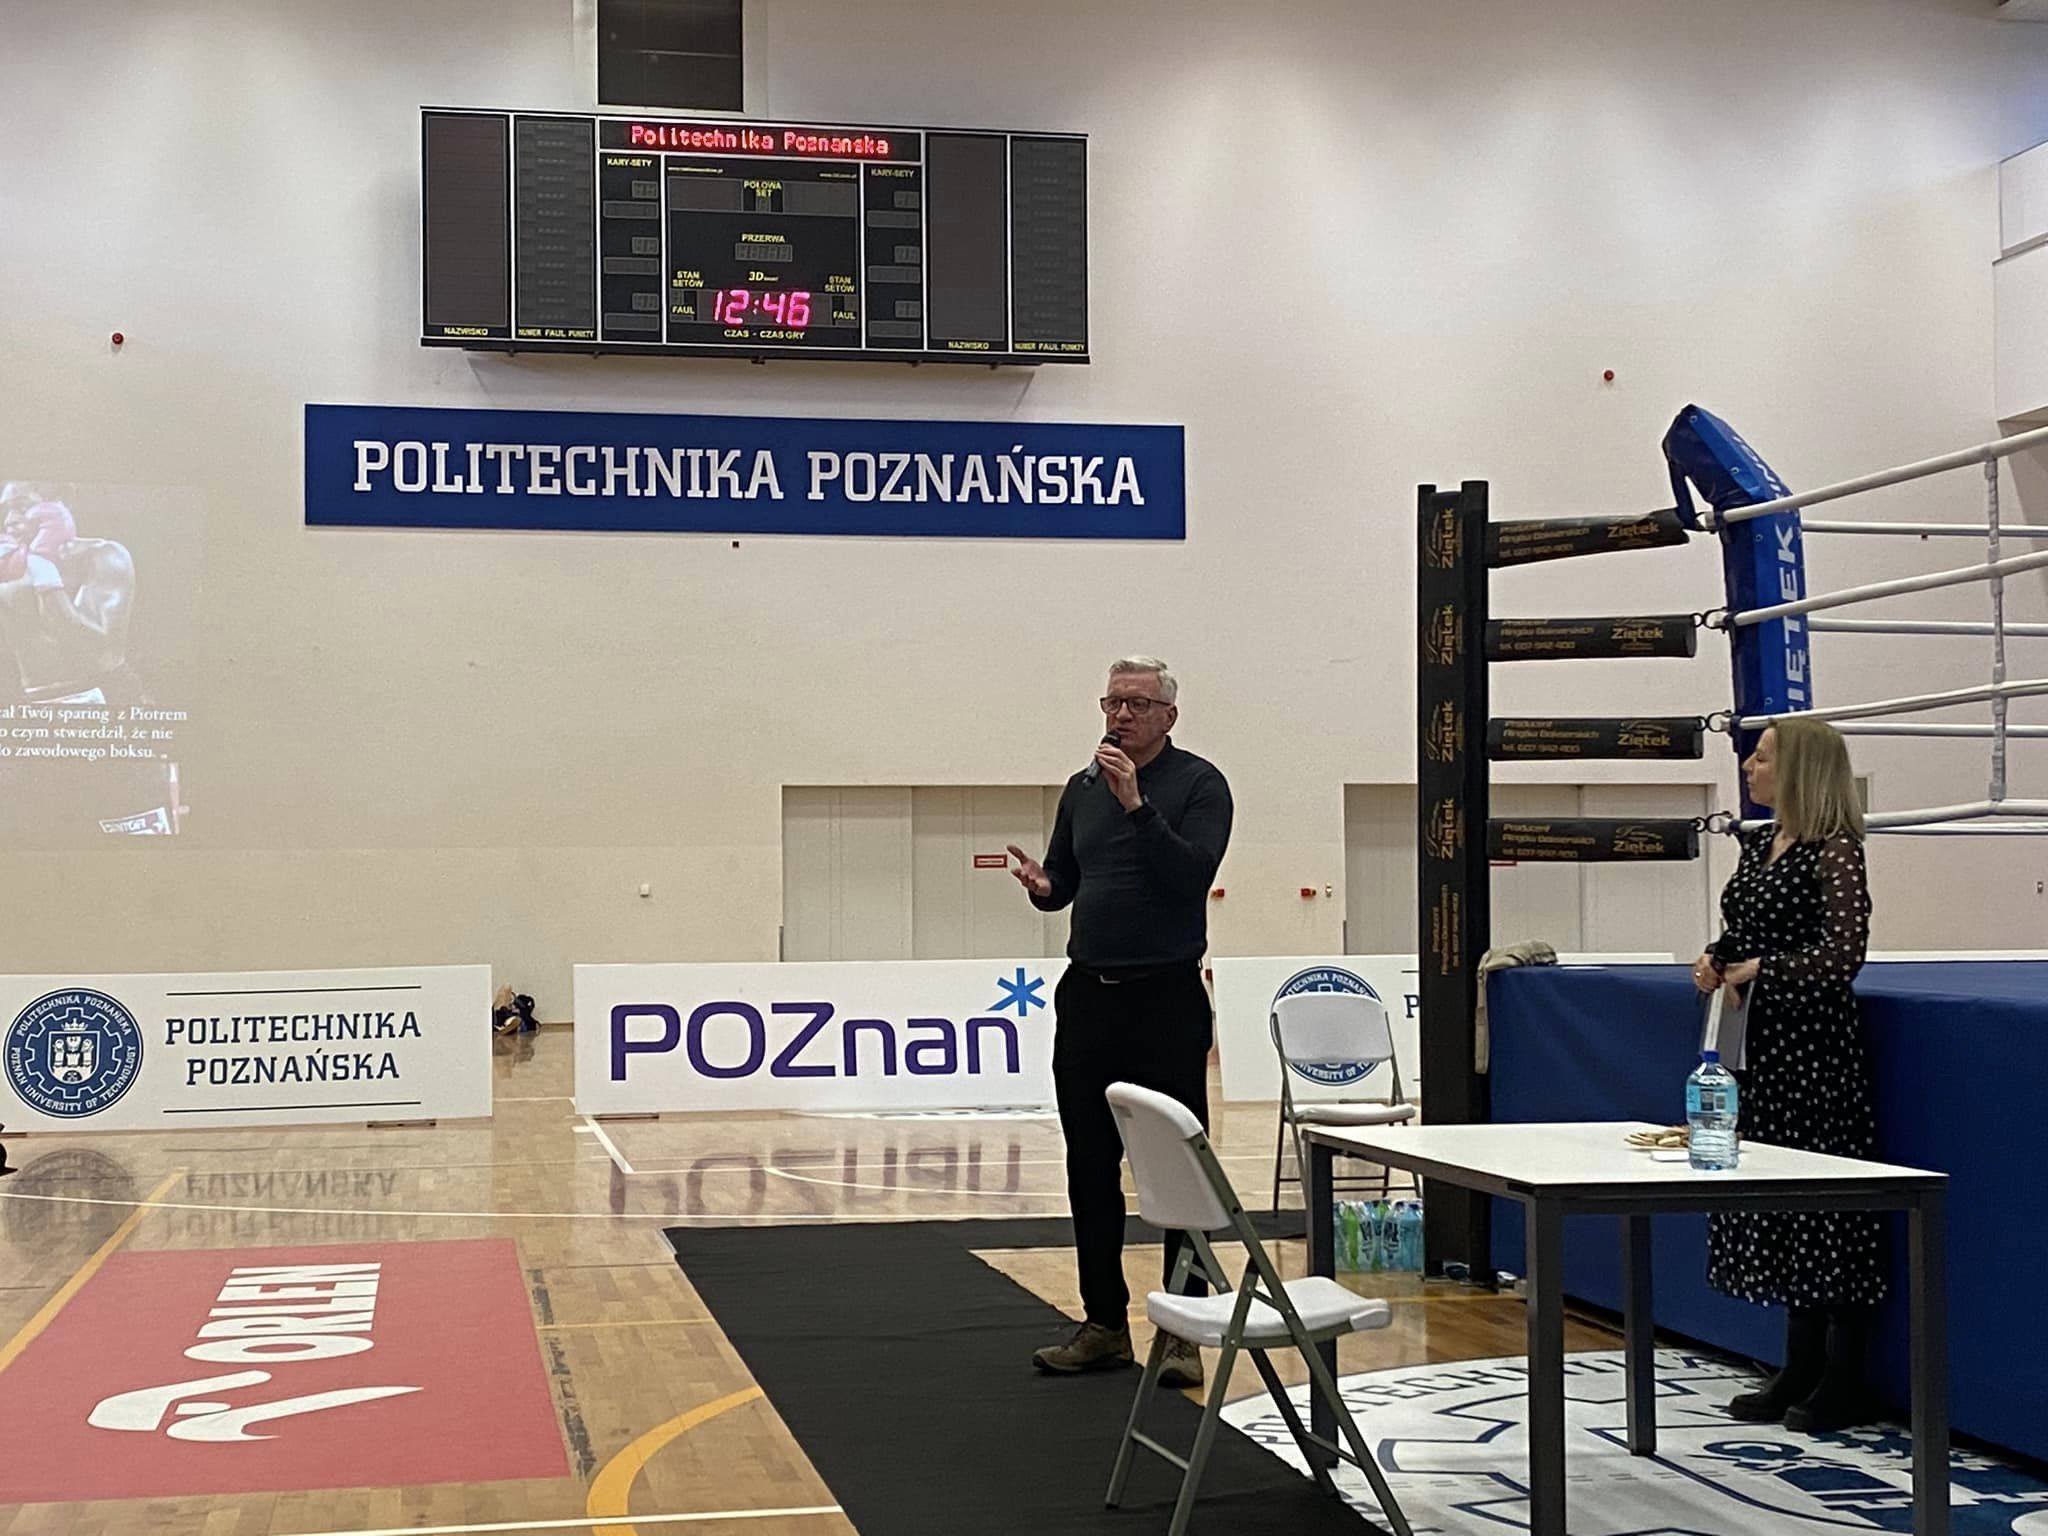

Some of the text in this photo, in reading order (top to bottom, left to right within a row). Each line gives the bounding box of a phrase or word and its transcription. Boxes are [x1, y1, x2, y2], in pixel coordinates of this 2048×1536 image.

[631, 125, 889, 154] Politechnika Poznanska
[742, 234, 785, 243] PRZERWA
[677, 271, 700, 279] STAN
[829, 276, 851, 284] STAN
[672, 306, 695, 314] FAUL
[714, 290, 811, 326] 12:46
[833, 311, 856, 320] FAUL
[724, 330, 749, 338] CZAS
[760, 331, 784, 339] CZAS
[786, 331, 805, 339] GRY
[353, 440, 1145, 506] POLITECHNIKA POZNAŃSKA
[1775, 521, 1806, 712] IĘTEK
[1611, 626, 1664, 642] Ziętek
[18, 705, 53, 723] Twój
[57, 706, 110, 723] sparing
[118, 711, 126, 720] z
[130, 706, 187, 720] Piotrem
[12, 728, 49, 741] czym
[131, 727, 147, 739] że
[152, 726, 174, 739] nie
[1617, 733, 1672, 749] Ziętek
[16, 743, 106, 761] zawodowego
[1613, 839, 1665, 856] Ziętek
[16, 995, 80, 1037] POLITECHNIKA
[165, 1010, 422, 1045] POLITECHNIKA
[186, 1047, 400, 1086] POZNAŃSKA
[24, 1084, 83, 1112] UNIVERSITY
[85, 1098, 98, 1110] OF
[99, 1045, 137, 1101] TECHNOLOGY
[183, 1262, 382, 1363] ORLEN
